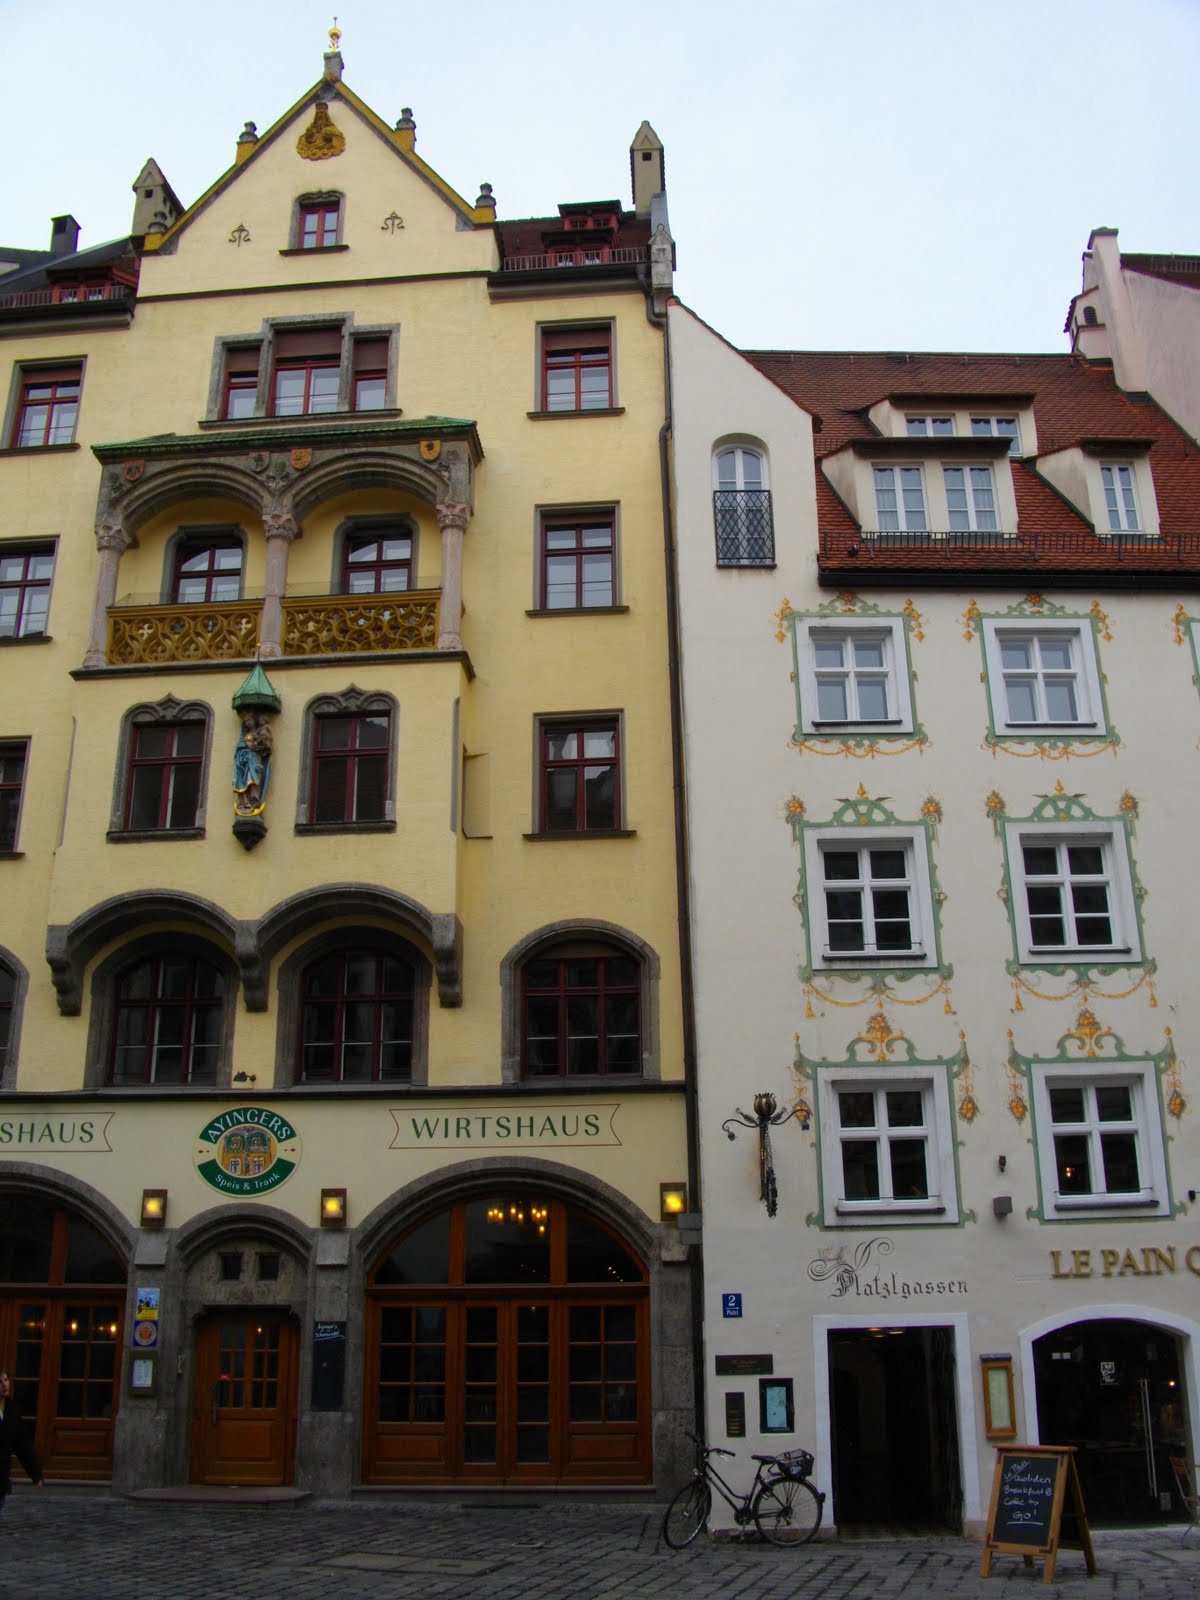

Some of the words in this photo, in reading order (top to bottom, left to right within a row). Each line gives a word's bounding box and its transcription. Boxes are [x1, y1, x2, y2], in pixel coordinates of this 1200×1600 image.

[0, 1121, 95, 1144] SHAUS
[207, 1109, 291, 1142] AYINGERS
[411, 1114, 601, 1139] WIRTSHAUS
[215, 1174, 240, 1190] Speis
[242, 1181, 251, 1191] &
[254, 1173, 281, 1189] Trank
[1050, 1250, 1093, 1278] LE
[1101, 1246, 1177, 1276] PAIN
[818, 1260, 969, 1300] Platzlgassen
[728, 1295, 736, 1306] 2
